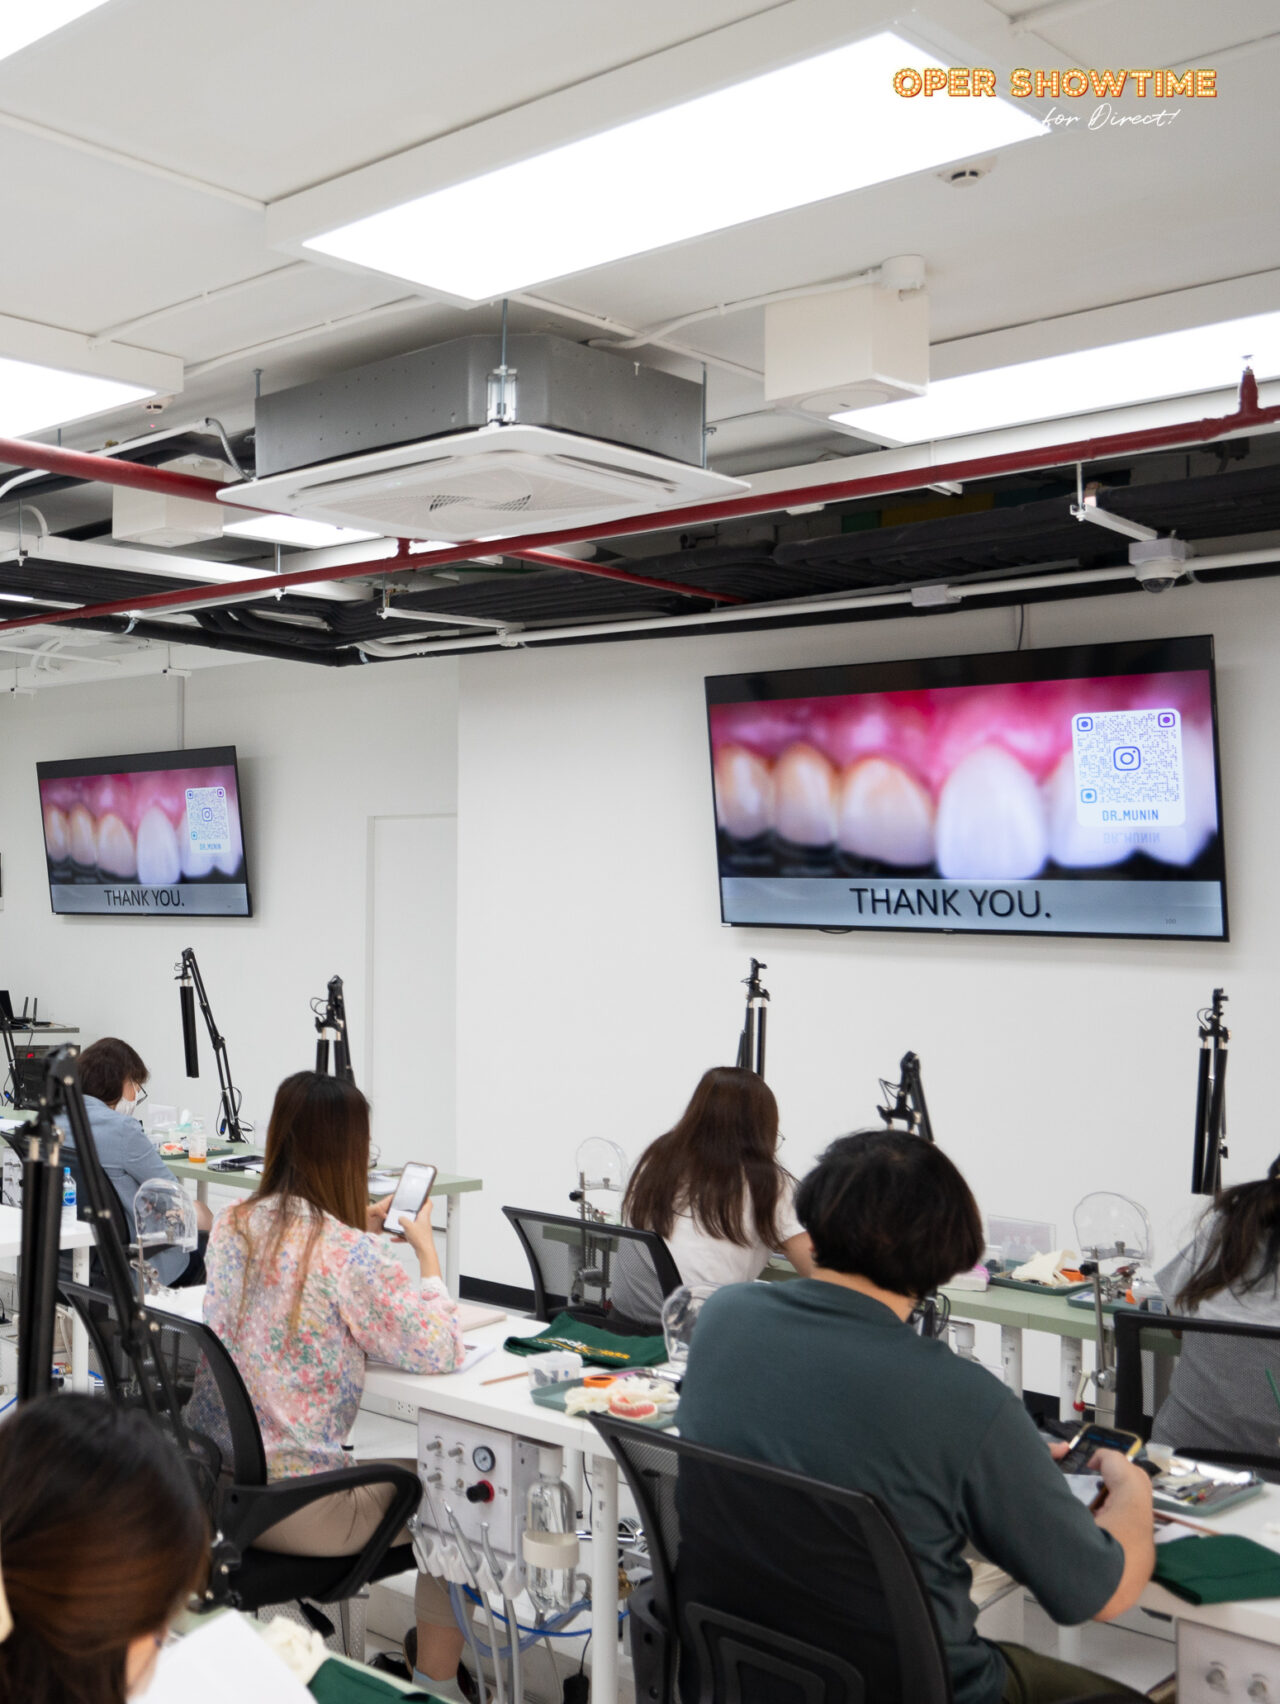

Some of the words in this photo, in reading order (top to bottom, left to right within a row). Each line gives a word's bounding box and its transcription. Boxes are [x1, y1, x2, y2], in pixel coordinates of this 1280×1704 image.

[1102, 809, 1159, 821] DR_MUNIN
[104, 890, 150, 906] THANK
[152, 890, 185, 907] YOU.
[849, 887, 962, 915] THANK
[969, 888, 1052, 919] YOU.
